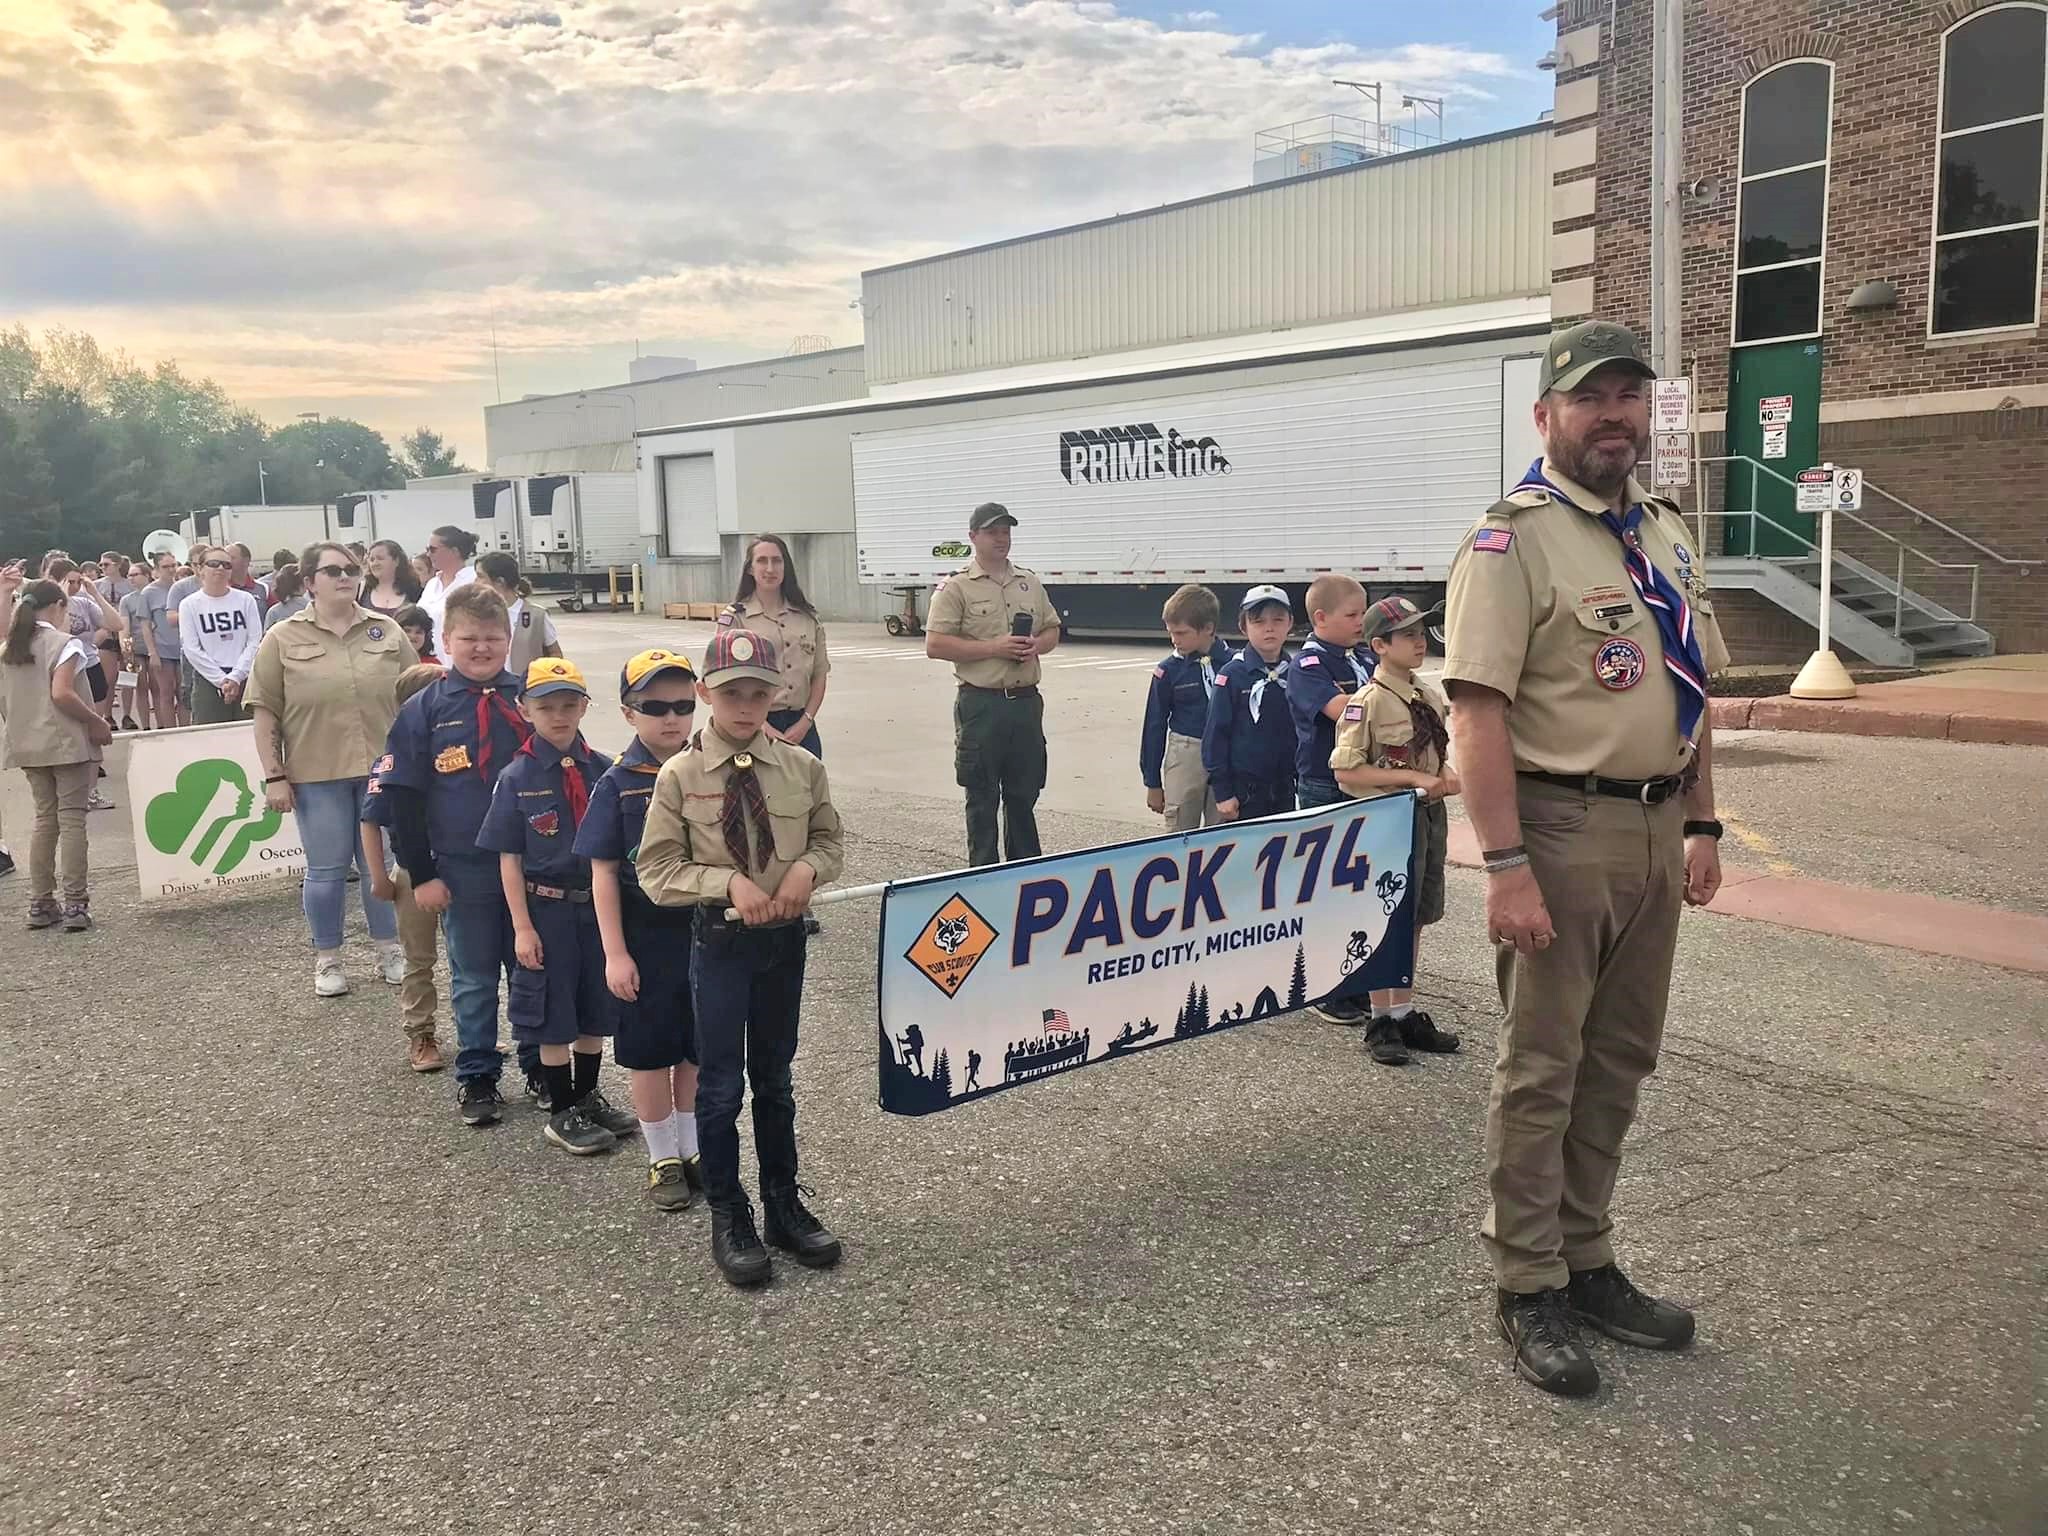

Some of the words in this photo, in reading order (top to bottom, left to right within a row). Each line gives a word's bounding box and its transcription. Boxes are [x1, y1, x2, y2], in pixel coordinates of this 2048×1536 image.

[1761, 410, 1773, 421] NO
[1657, 447, 1688, 458] PARKING
[1667, 438, 1678, 447] NO
[1060, 423, 1169, 485] PRIME
[932, 545, 954, 557] eco
[199, 610, 247, 633] USA
[161, 882, 200, 895] Daisy
[216, 871, 271, 887] Brownie
[1010, 842, 1236, 968] PACK
[1255, 815, 1371, 912] 174
[1088, 956, 1145, 984] REED
[1152, 940, 1200, 970] CITY,
[1205, 917, 1304, 956] MICHIGAN
[927, 961, 945, 974] CUB
[946, 953, 979, 971] SCOUTS
